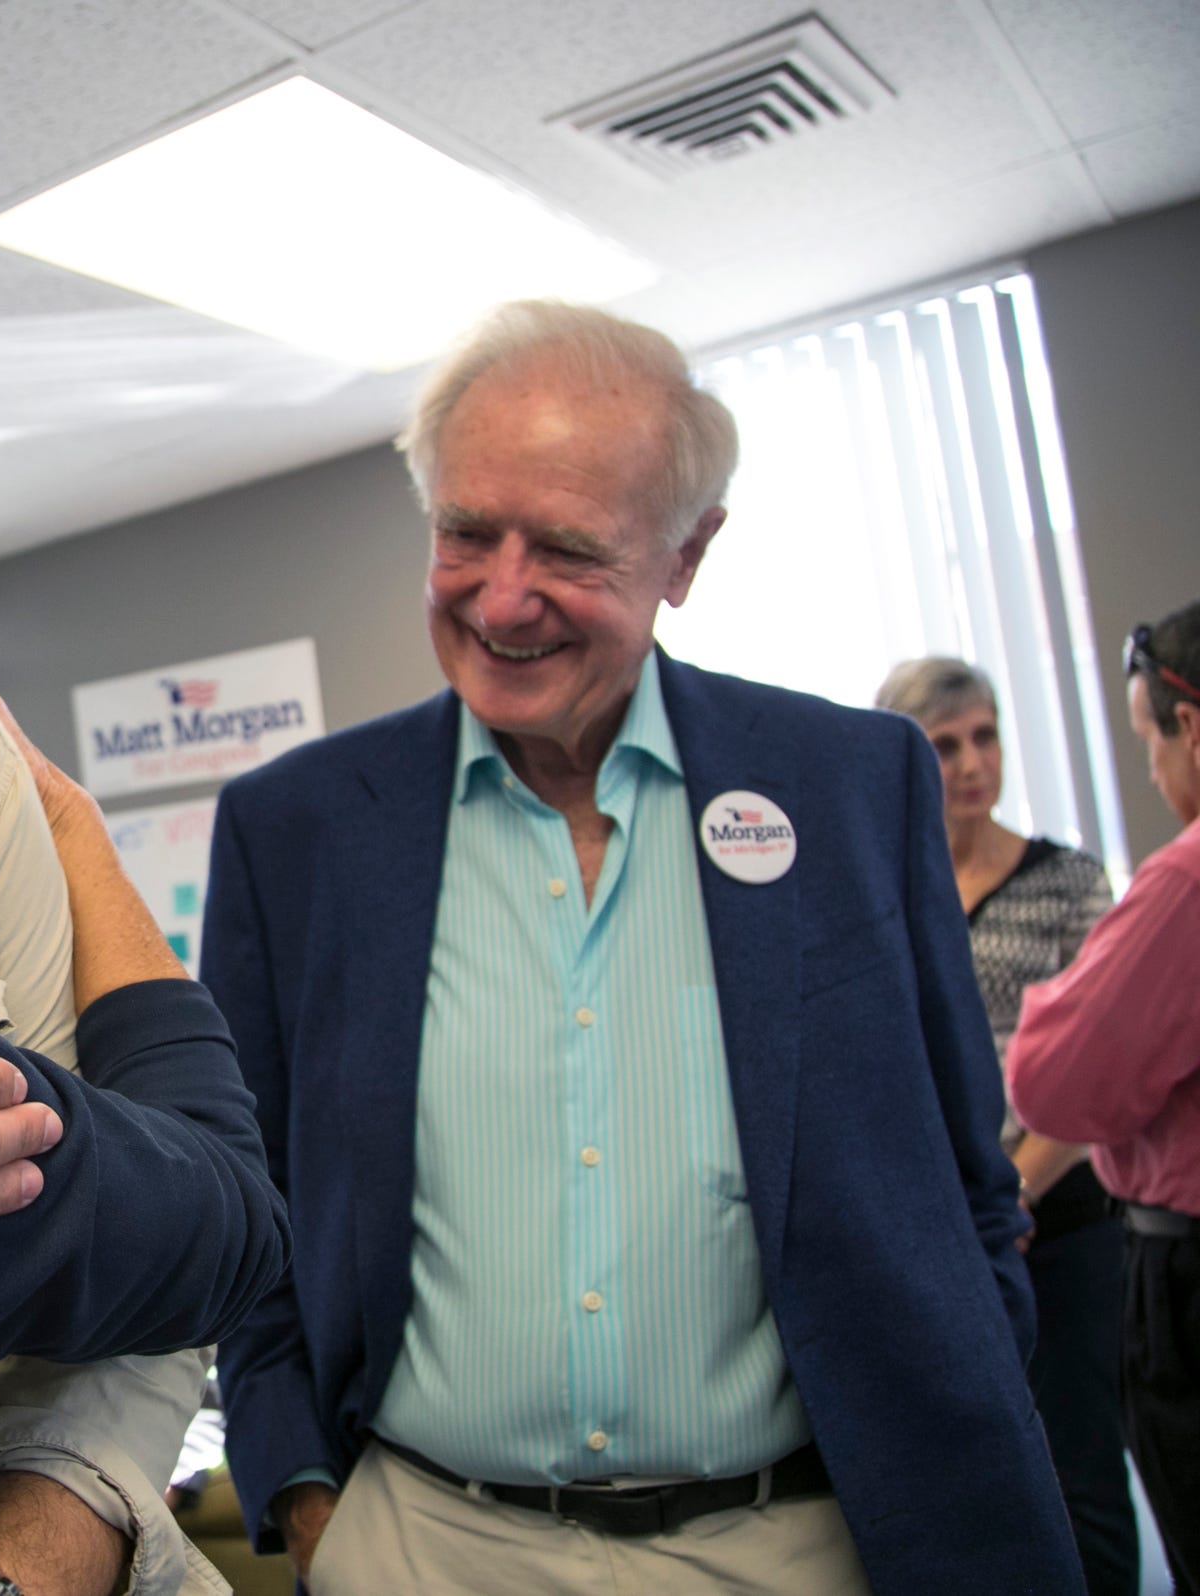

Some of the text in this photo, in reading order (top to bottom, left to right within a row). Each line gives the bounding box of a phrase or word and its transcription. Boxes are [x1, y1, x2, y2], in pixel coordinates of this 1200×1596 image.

[93, 699, 304, 759] Matt Morgan
[709, 824, 792, 842] Morgan
